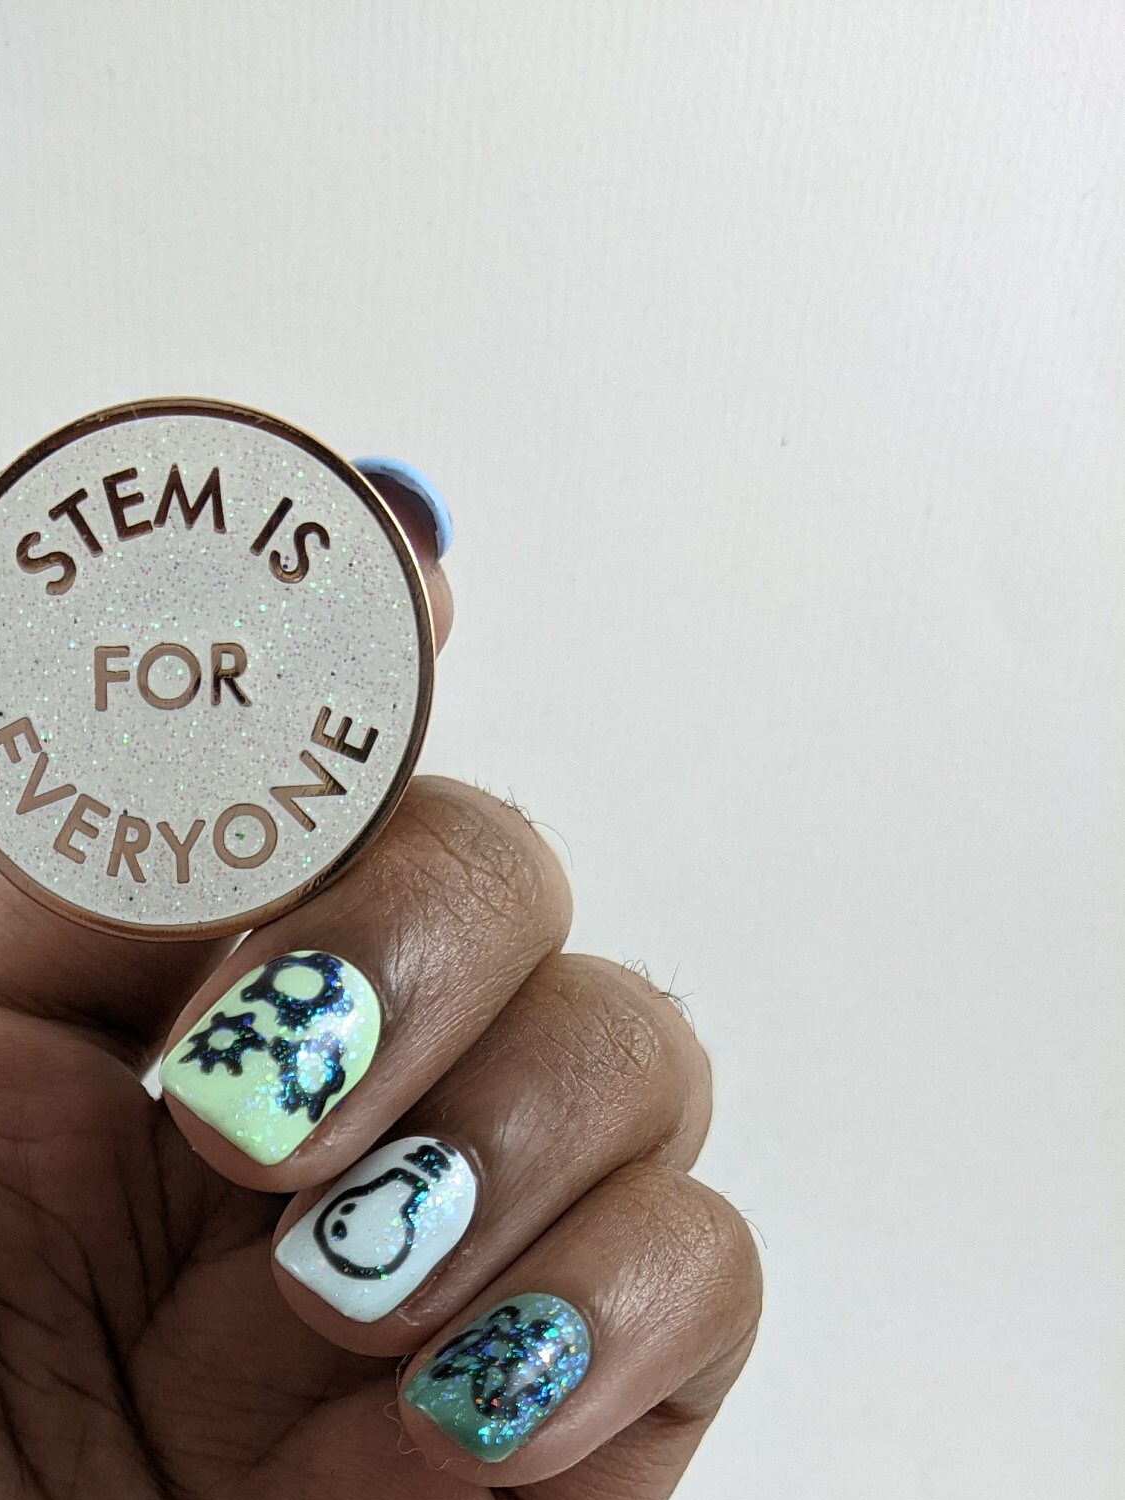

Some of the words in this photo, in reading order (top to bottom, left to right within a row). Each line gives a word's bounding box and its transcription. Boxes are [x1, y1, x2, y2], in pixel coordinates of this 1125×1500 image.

[16, 463, 227, 595] STEM
[250, 497, 330, 583] IS
[93, 642, 252, 711] FOR
